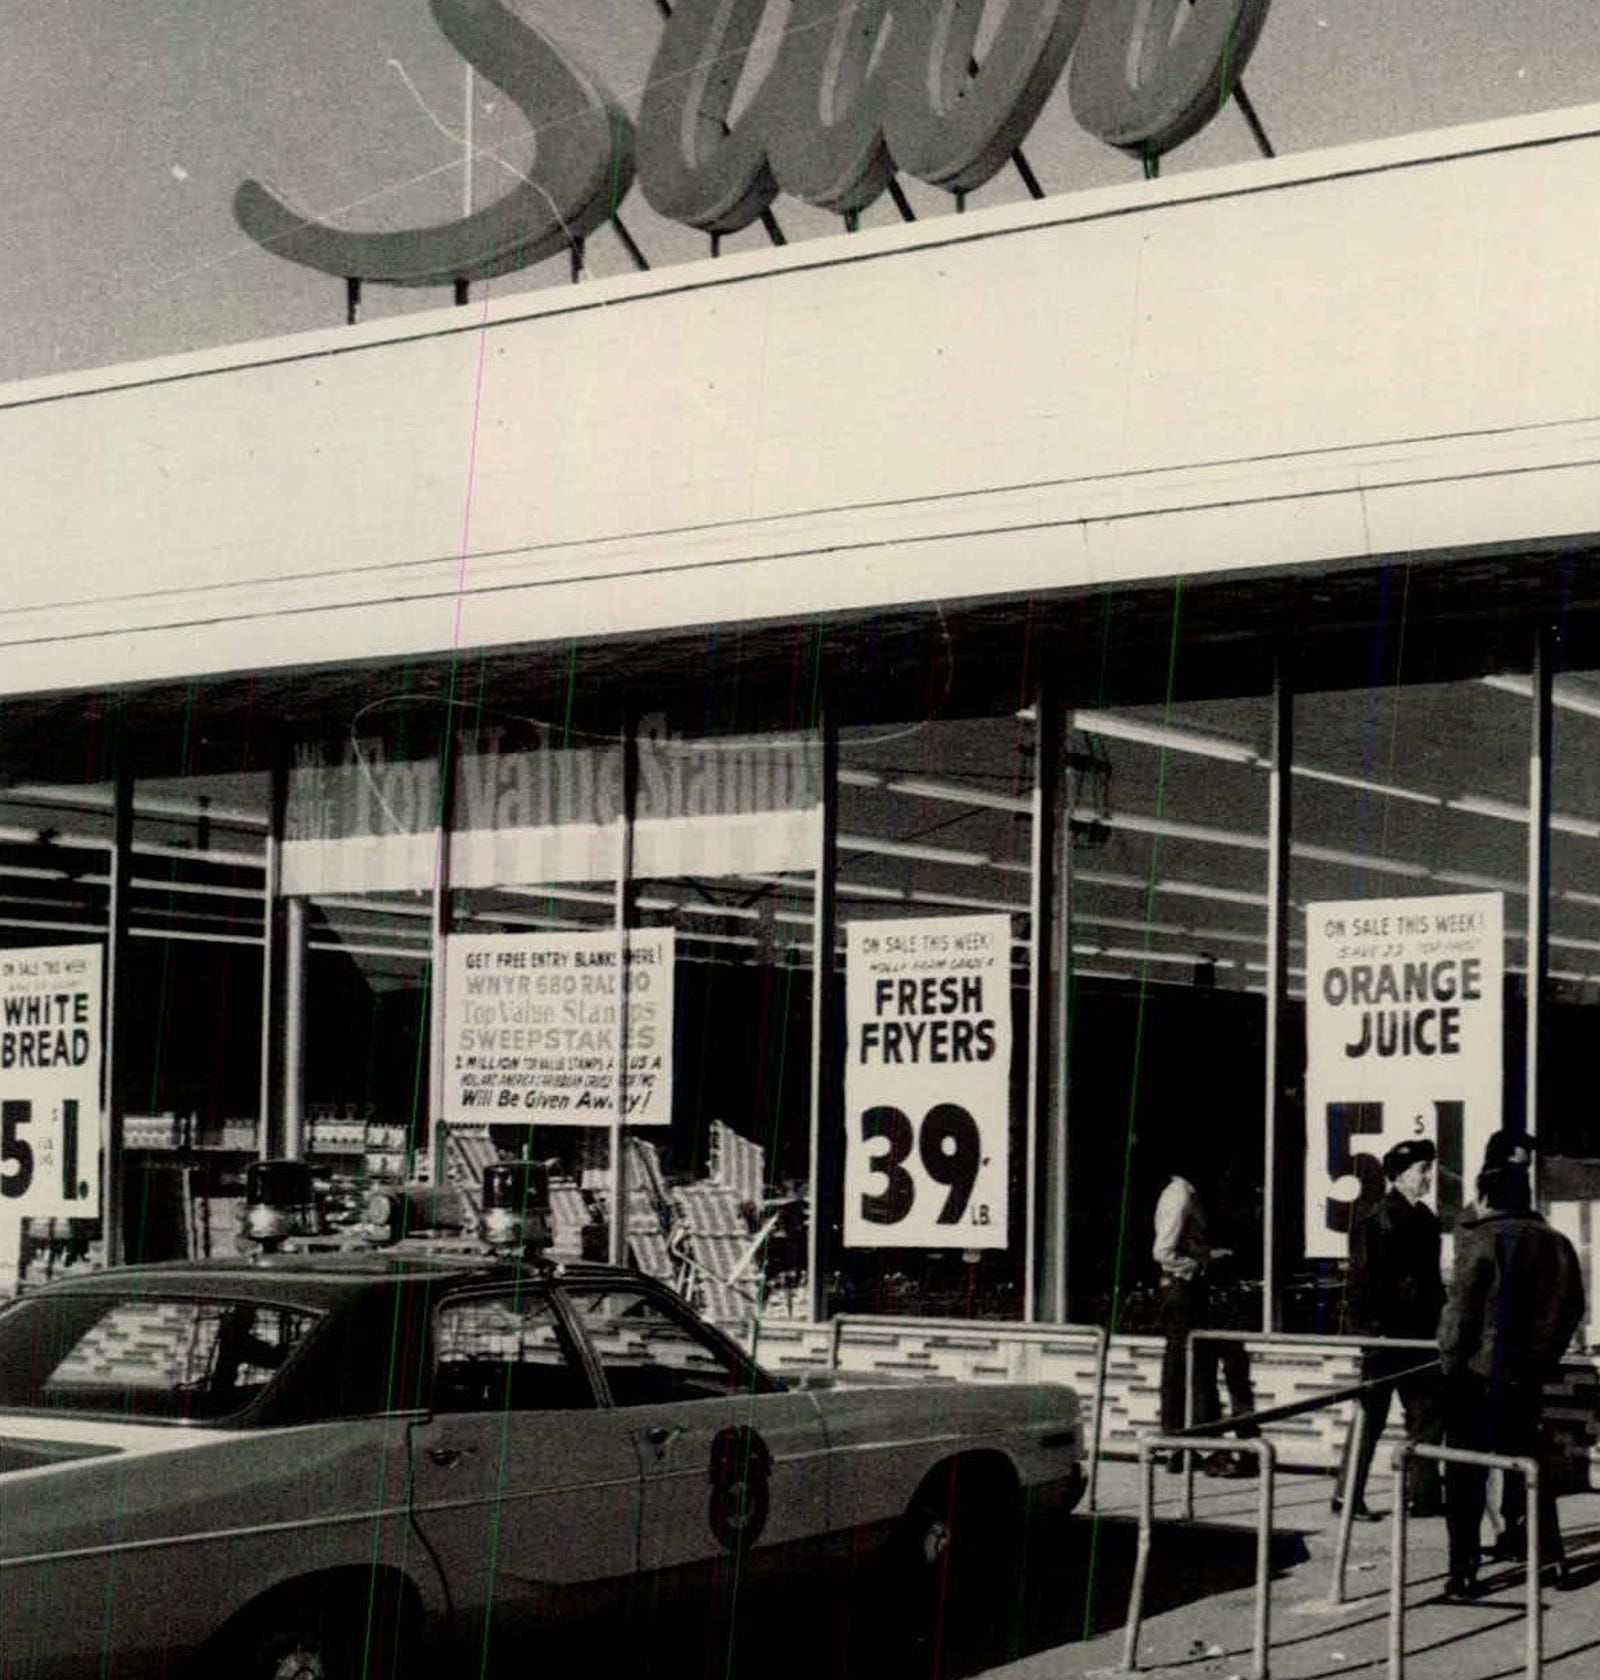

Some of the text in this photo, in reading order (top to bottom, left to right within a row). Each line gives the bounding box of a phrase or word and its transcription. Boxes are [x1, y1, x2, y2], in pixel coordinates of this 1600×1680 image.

[456, 724, 624, 829] Value
[1324, 919, 1346, 938] ON
[1352, 917, 1389, 936] SALE
[1397, 915, 1429, 935] THIS
[466, 953, 491, 969] GET
[496, 951, 526, 968] FREE
[530, 951, 568, 968] ENTRY
[628, 944, 662, 966] ERE!
[885, 935, 917, 954] SALE
[466, 971, 651, 995] WNYR 680 RAO
[876, 976, 983, 1016] FRESH
[1323, 958, 1481, 1006] ORANGE
[5, 994, 89, 1026] WHITE
[499, 999, 555, 1025] Value
[1, 1029, 89, 1068] BREAD
[860, 1020, 996, 1064] FRYERS
[1345, 1008, 1460, 1058] JUICE
[466, 1055, 521, 1071] MILLION
[461, 1089, 651, 1114] Will Be Given Awy!
[1, 1099, 34, 1199] 5
[1326, 1101, 1385, 1234] 5
